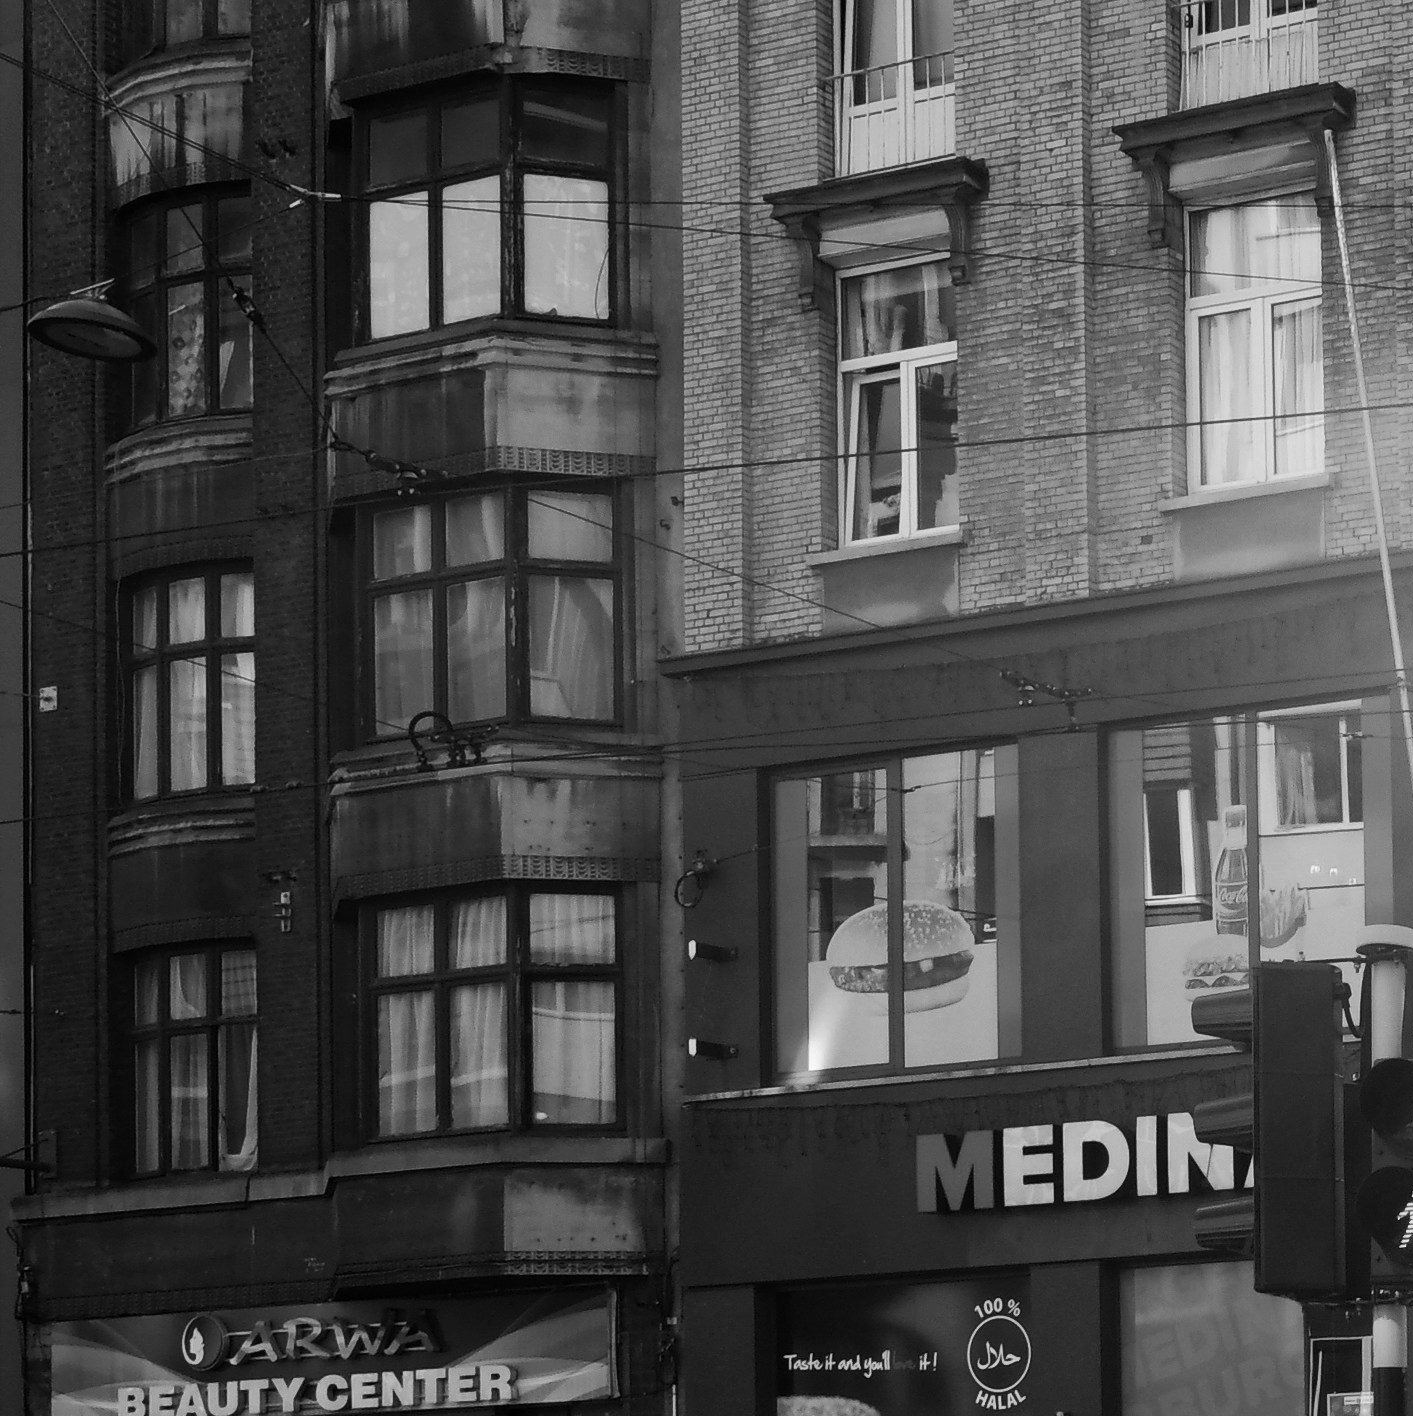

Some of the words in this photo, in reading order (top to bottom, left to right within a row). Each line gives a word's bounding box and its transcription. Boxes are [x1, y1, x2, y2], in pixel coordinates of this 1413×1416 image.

[916, 1111, 1254, 1213] MEDIN
[974, 1298, 1003, 1319] 100
[1008, 1299, 1021, 1318] %
[229, 1308, 447, 1366] ARWA
[784, 1353, 823, 1371] Taste
[825, 1353, 836, 1370] it
[838, 1354, 862, 1371] and
[864, 1350, 891, 1378] you'll
[315, 1365, 517, 1411] CENTER
[976, 1390, 1027, 1411] HALAL
